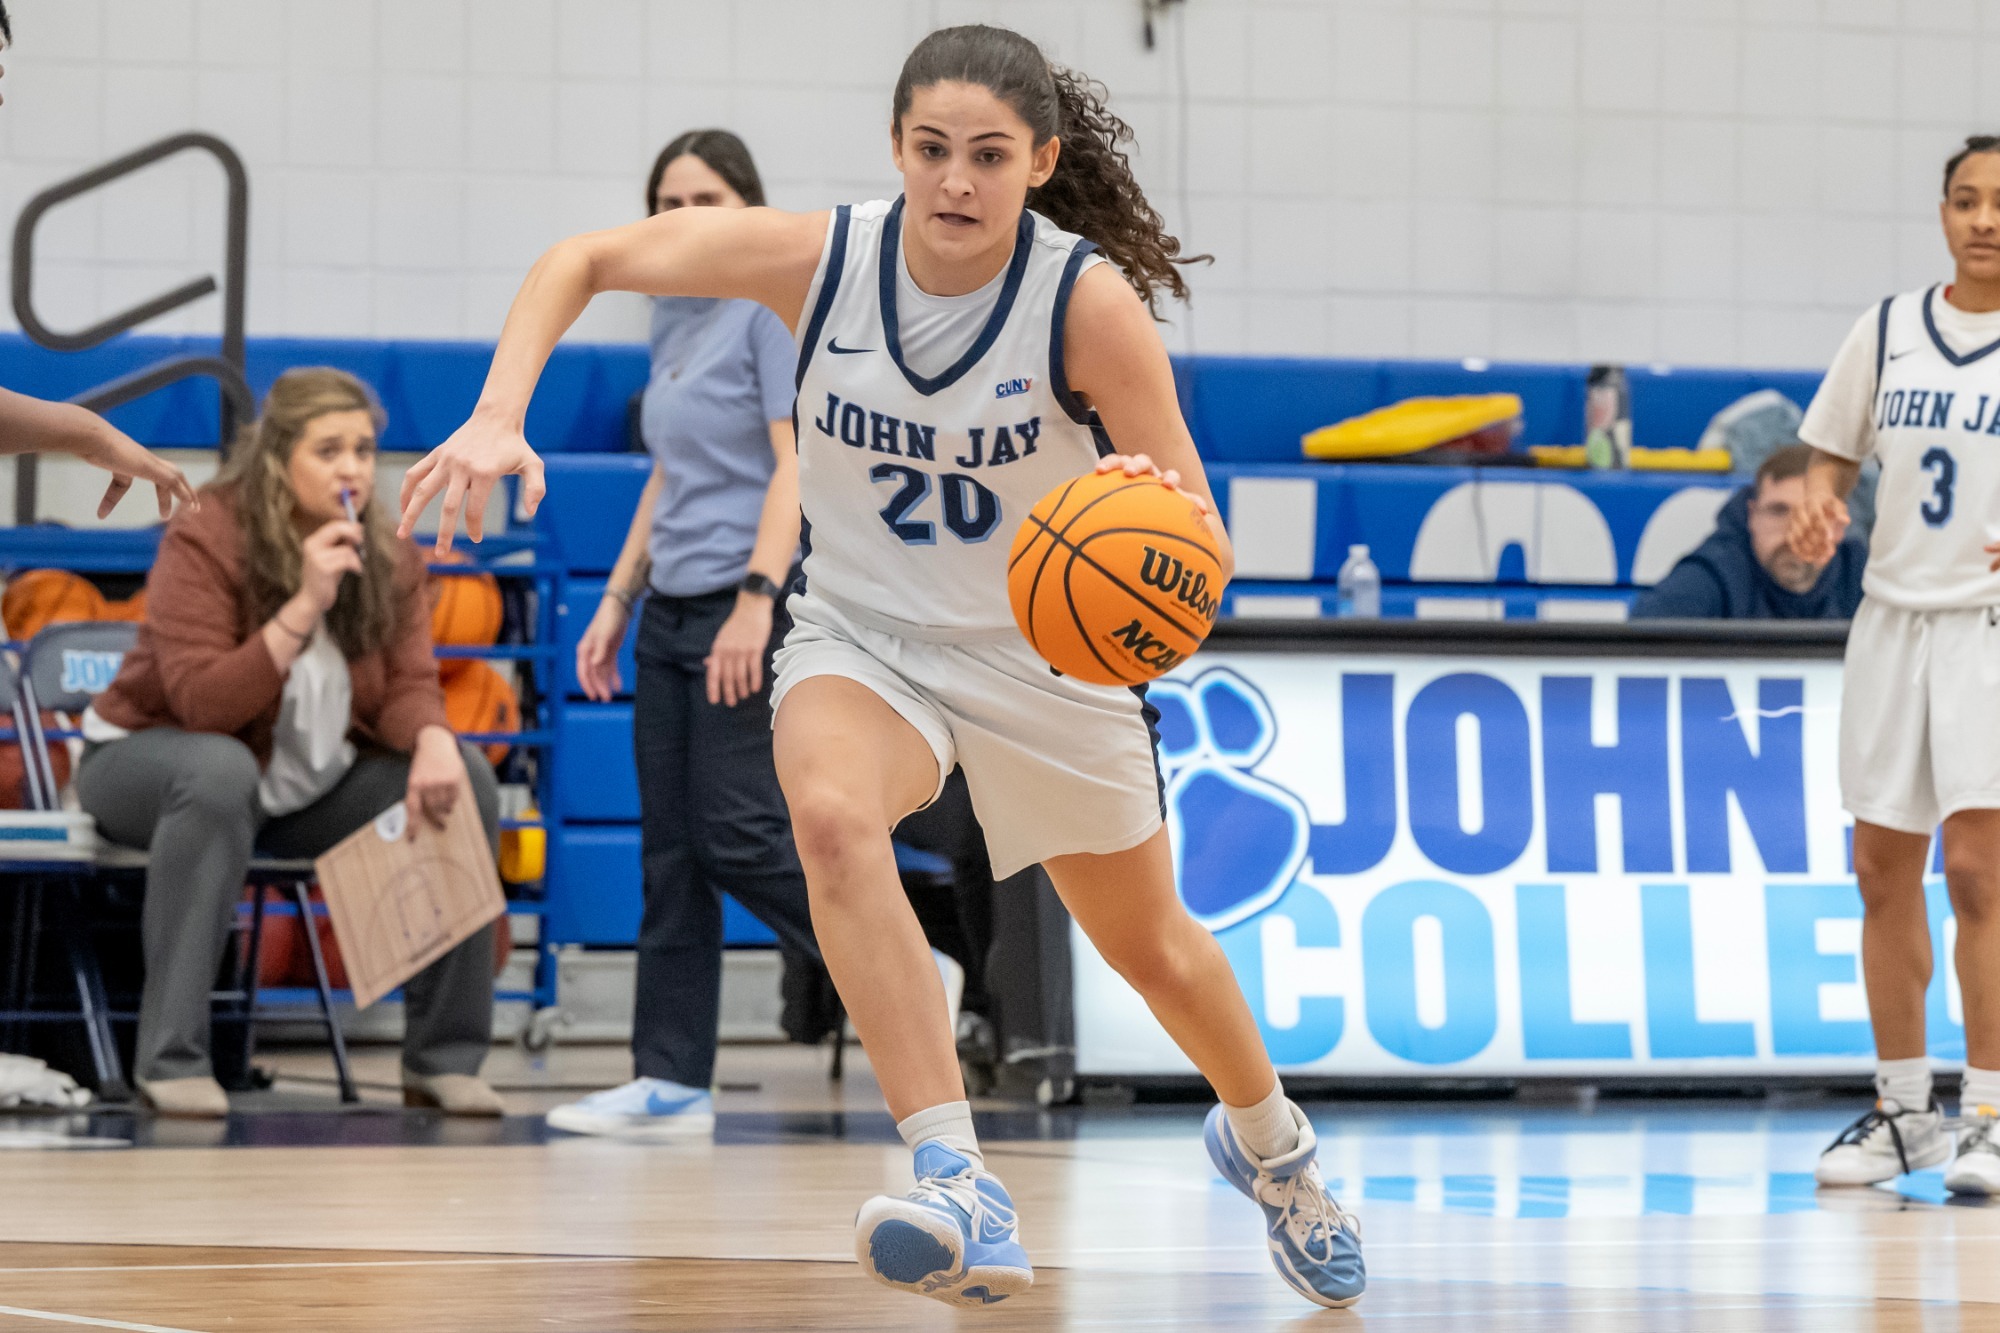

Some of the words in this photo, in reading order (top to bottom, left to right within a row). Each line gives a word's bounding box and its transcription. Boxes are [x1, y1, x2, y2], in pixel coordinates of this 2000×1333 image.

[996, 378, 1032, 397] CUNY
[1879, 390, 1955, 430] JOHN
[815, 392, 936, 462] JOHN
[955, 416, 1041, 469] JAY
[869, 462, 1003, 546] 20
[1920, 446, 1957, 529] 3
[1140, 545, 1219, 622] Wilso
[1309, 672, 1809, 875] JOHN
